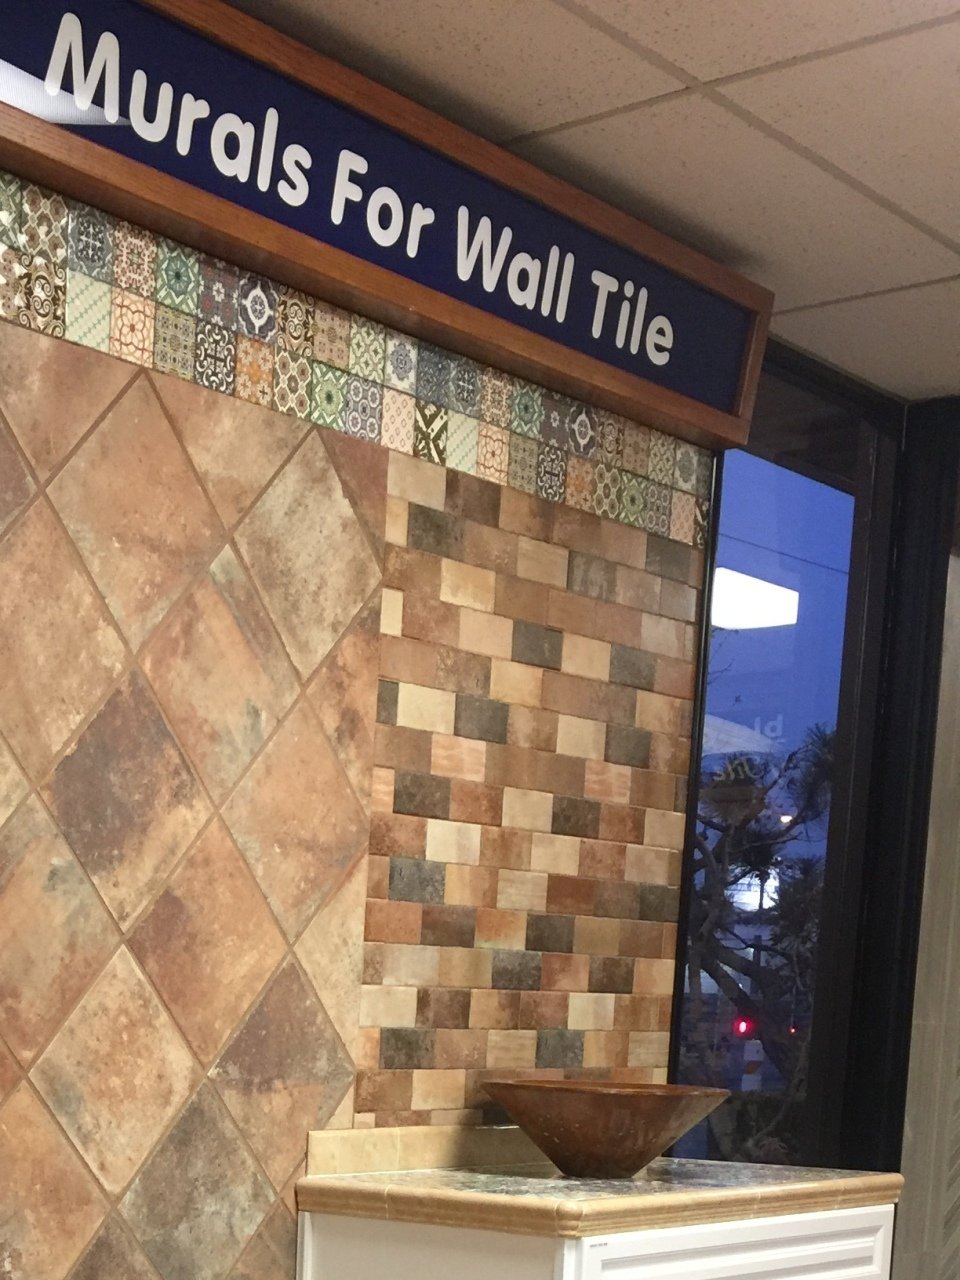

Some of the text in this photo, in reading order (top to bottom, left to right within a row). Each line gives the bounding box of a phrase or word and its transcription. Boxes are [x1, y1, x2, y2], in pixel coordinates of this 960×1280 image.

[44, 12, 675, 366] Murals For Wall Tile
